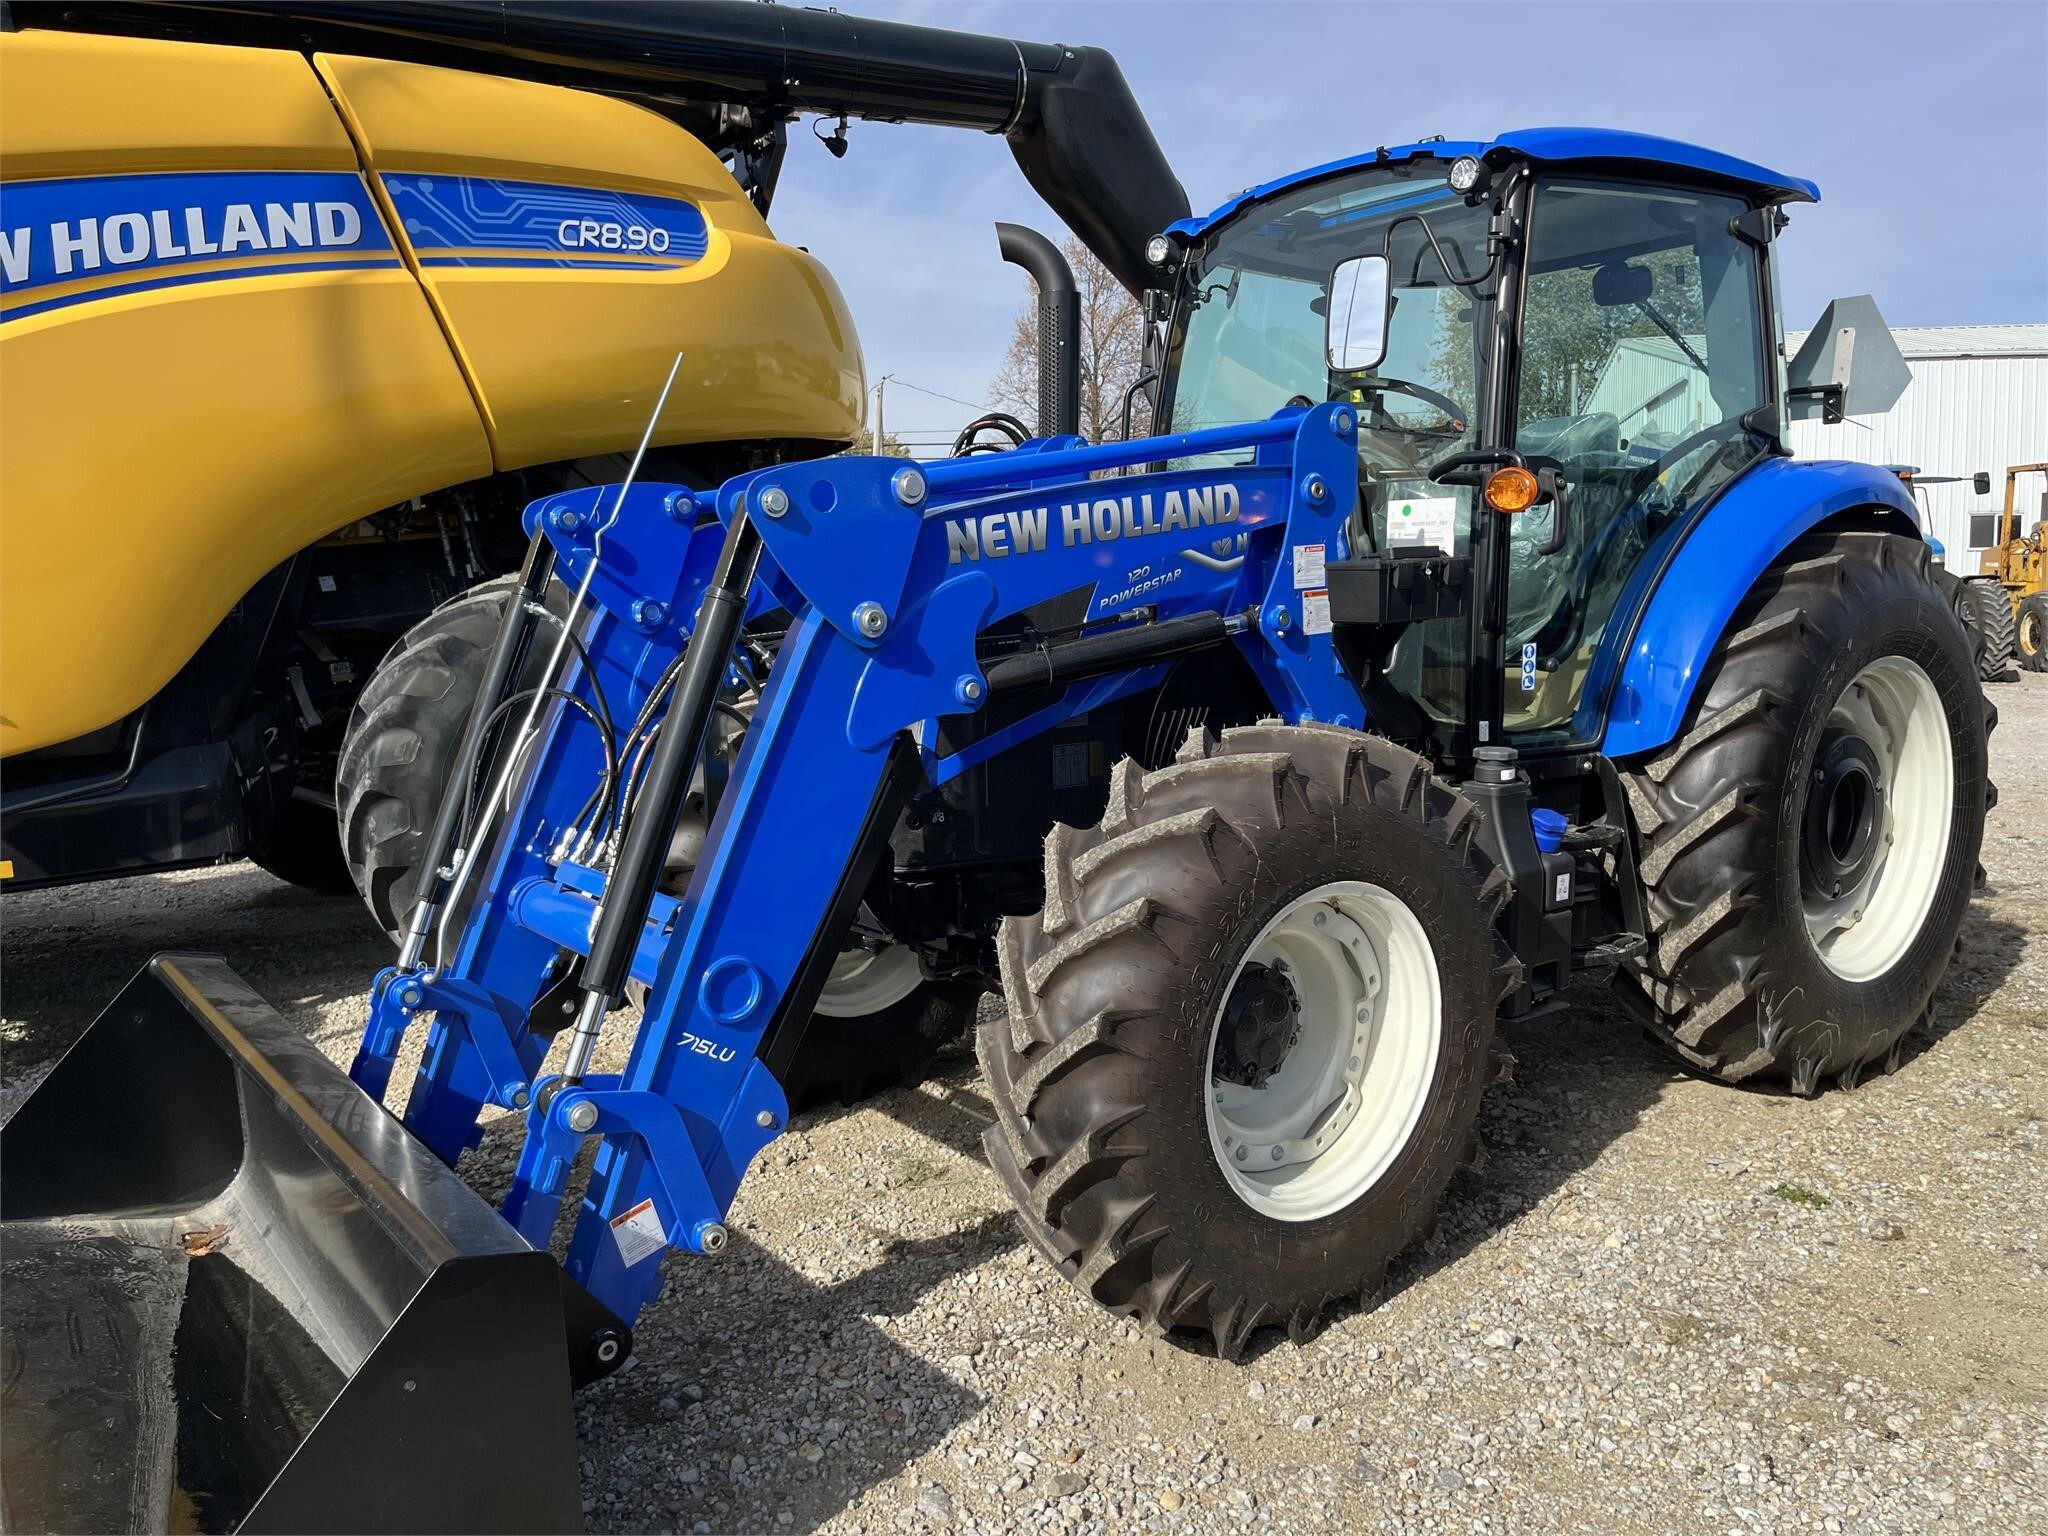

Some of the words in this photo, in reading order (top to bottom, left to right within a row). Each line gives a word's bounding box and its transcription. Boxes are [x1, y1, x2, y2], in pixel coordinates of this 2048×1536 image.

[51, 202, 361, 274] HOLLAND
[558, 219, 670, 252] CR8.90
[946, 508, 1048, 564] NEW
[1061, 483, 1240, 547] HOLLAND
[1100, 568, 1182, 611] POWERSTAR
[1128, 565, 1151, 584] 120
[676, 1032, 736, 1062] 715LU
